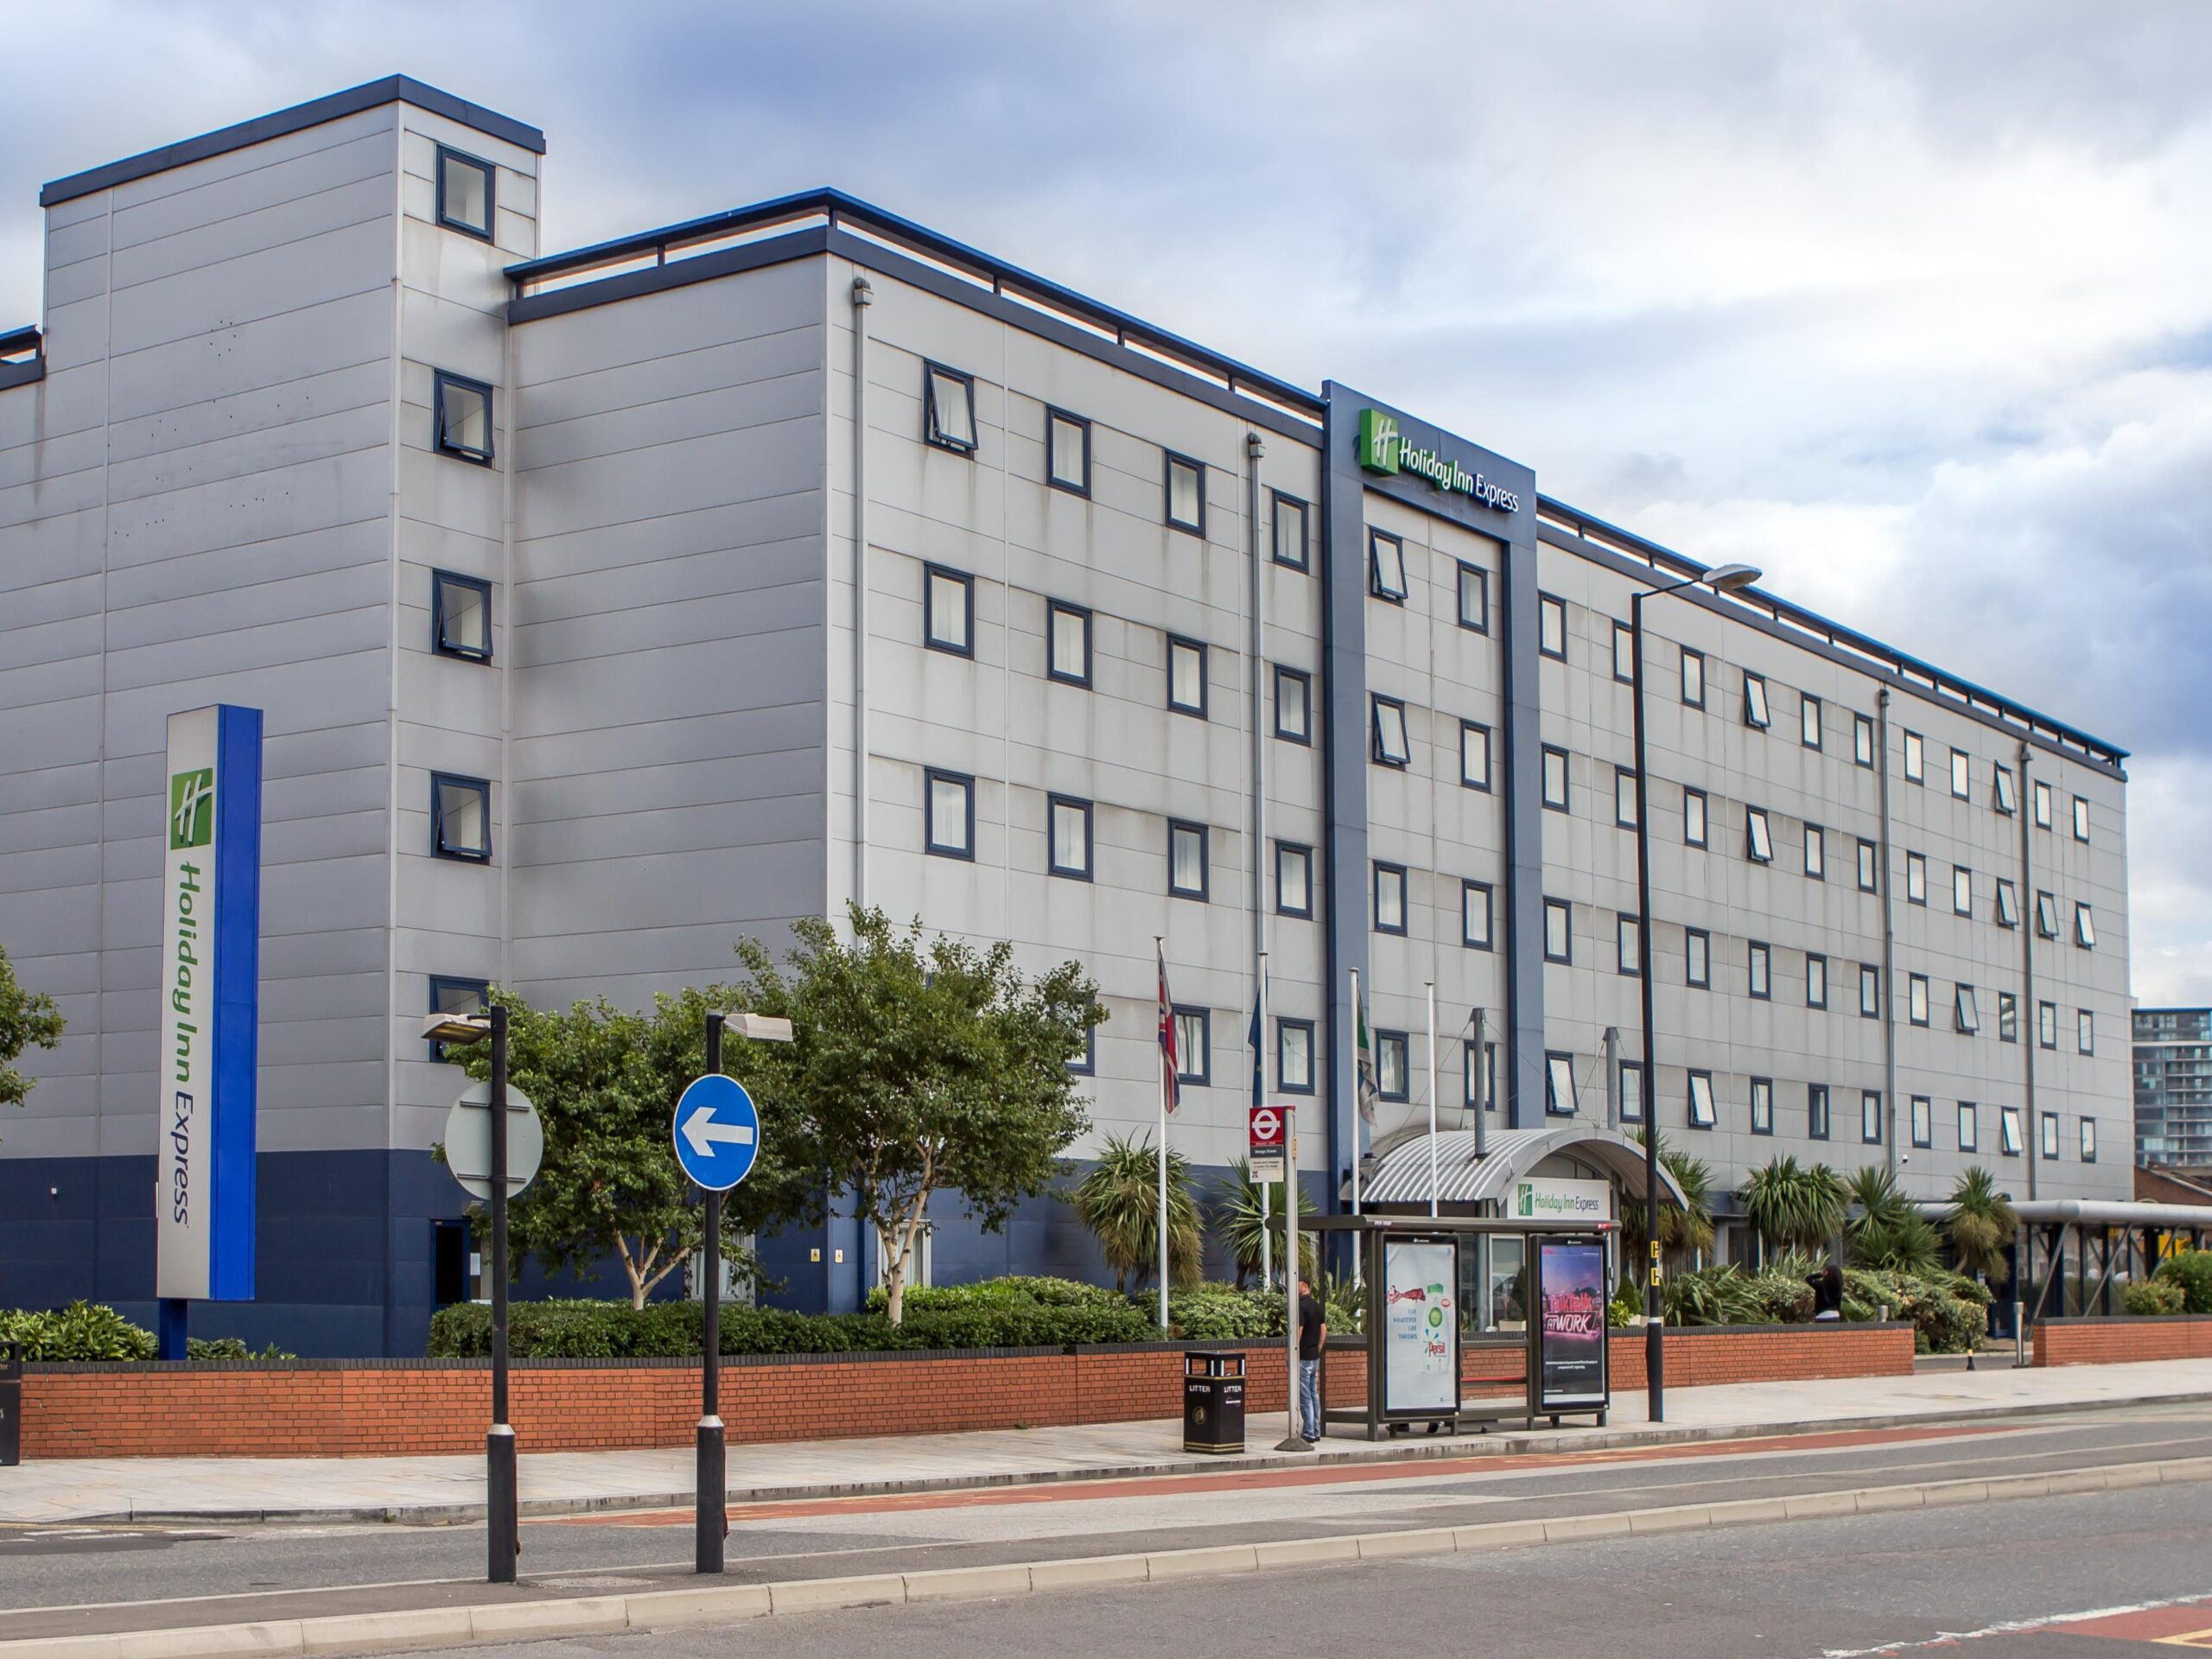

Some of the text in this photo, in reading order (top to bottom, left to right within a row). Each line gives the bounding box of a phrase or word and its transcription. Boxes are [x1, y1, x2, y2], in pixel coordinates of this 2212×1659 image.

[1399, 436, 1519, 512] Holiday Inn Express
[171, 861, 200, 1226] Holiday Inn Express
[1535, 1192, 1599, 1213] Holiday Inn Express
[1556, 1313, 1591, 1332] WORK
[1428, 1341, 1446, 1357] Persil
